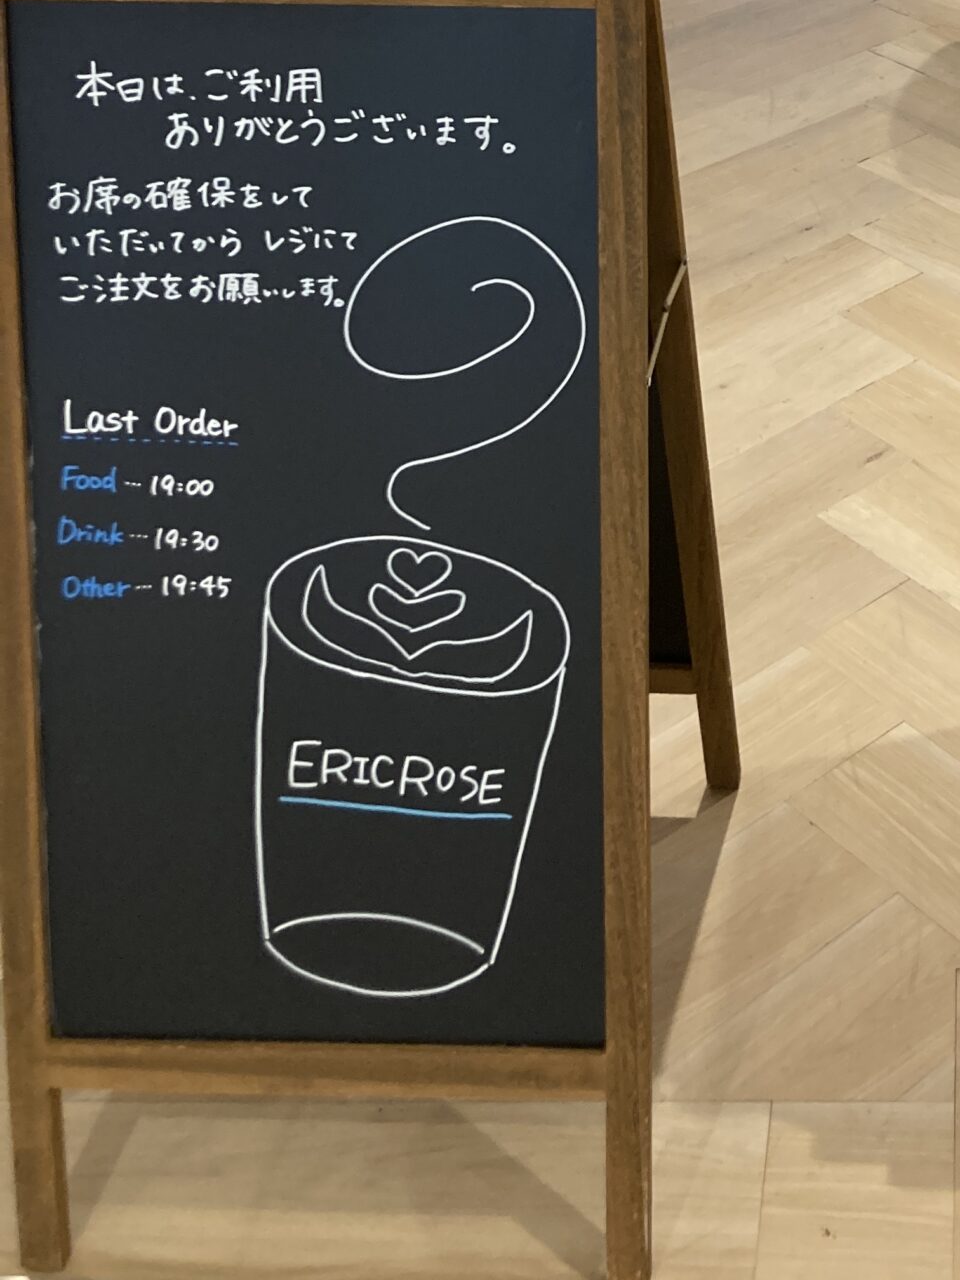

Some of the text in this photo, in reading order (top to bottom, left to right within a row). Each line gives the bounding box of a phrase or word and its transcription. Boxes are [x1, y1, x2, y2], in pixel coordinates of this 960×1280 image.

[165, 109, 517, 154] ありがとうございます。
[48, 176, 312, 215] お席の確保をして
[54, 225, 357, 257] いただいてから レジにて
[60, 272, 345, 308] ご注文をお願いします。
[63, 398, 239, 437] Last Order
[61, 465, 215, 496] Food 19:00
[57, 515, 219, 551] Drink 19:30
[62, 574, 232, 598] Other 19:45
